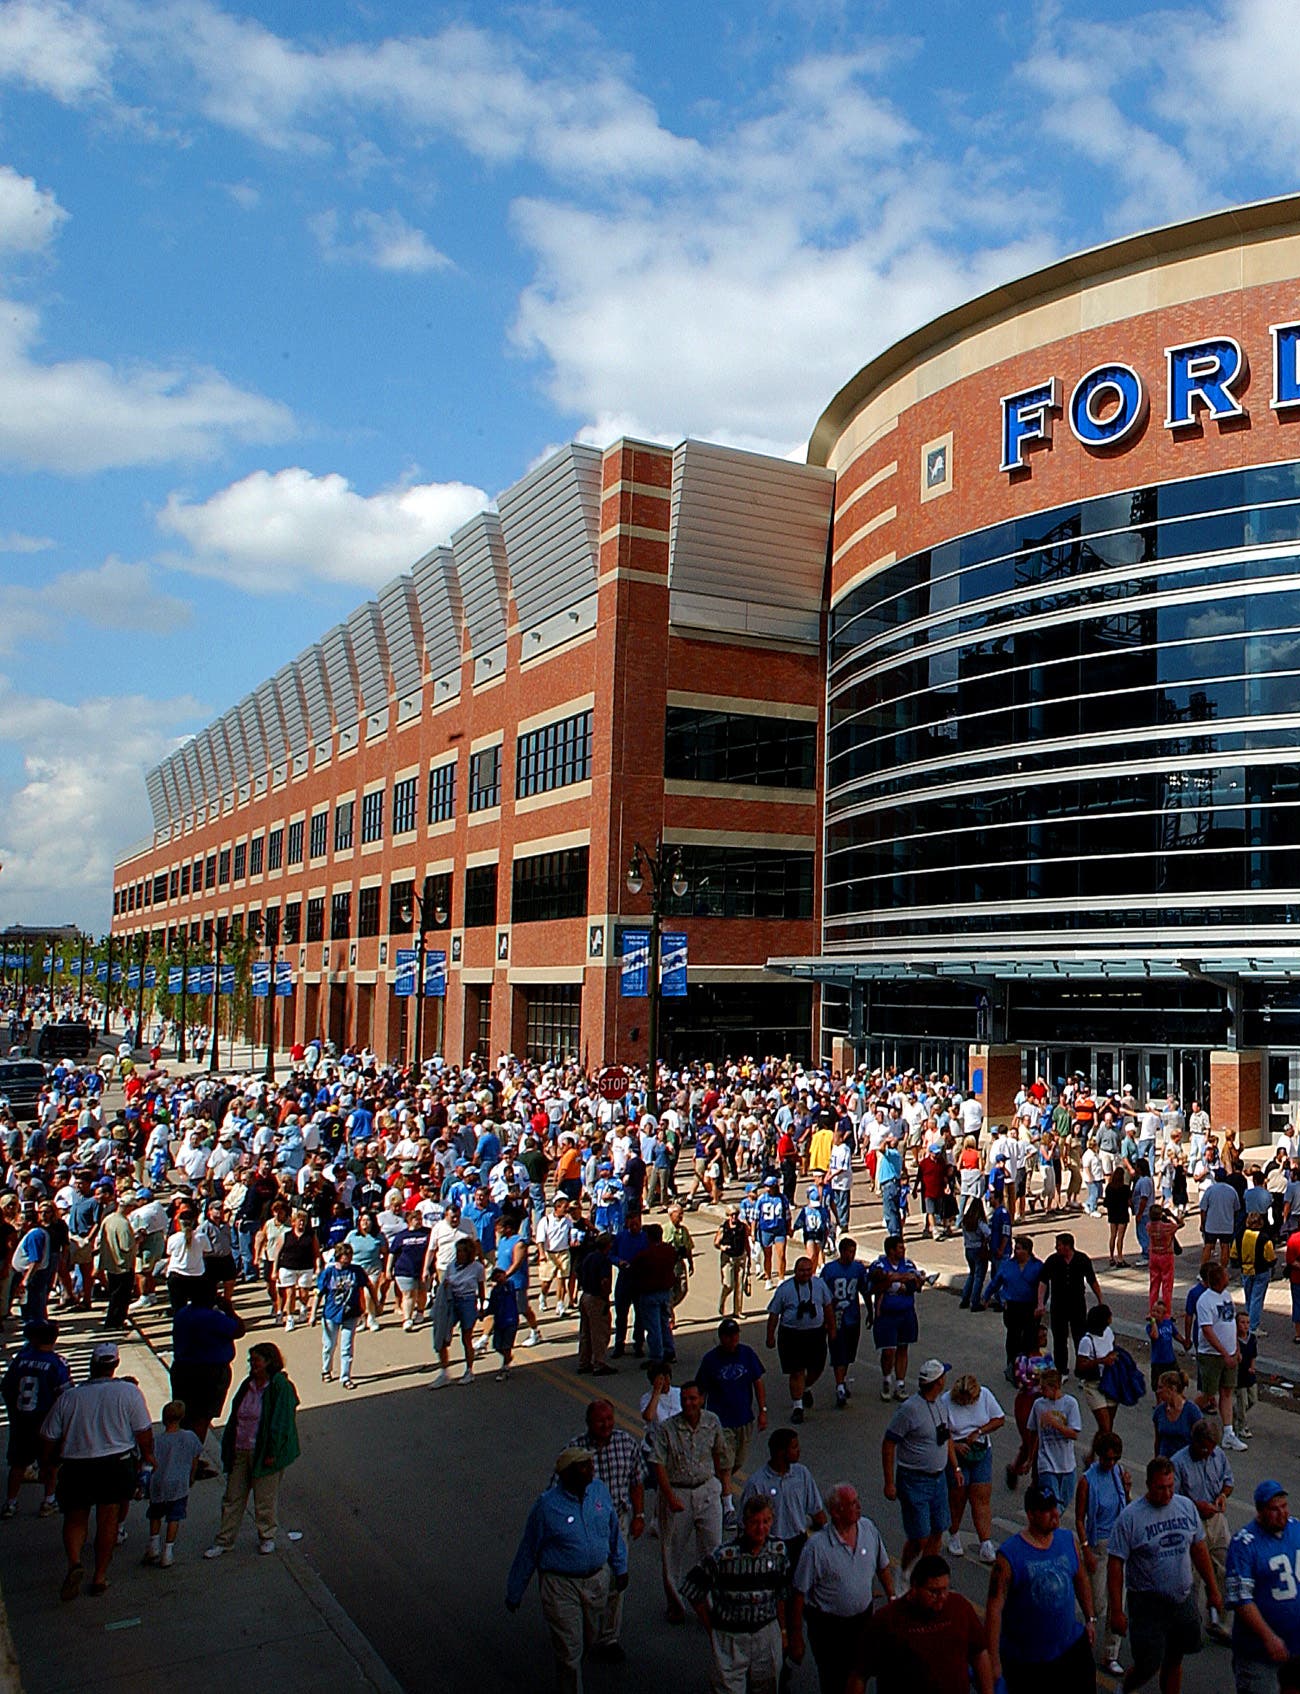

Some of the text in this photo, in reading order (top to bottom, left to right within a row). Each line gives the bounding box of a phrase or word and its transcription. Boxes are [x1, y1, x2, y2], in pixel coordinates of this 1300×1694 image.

[600, 1077, 628, 1091] STOP
[331, 1123, 340, 1138] 2
[833, 1277, 858, 1301] 84
[17, 1375, 40, 1412] 8
[1145, 1514, 1197, 1540] MICHIGAN
